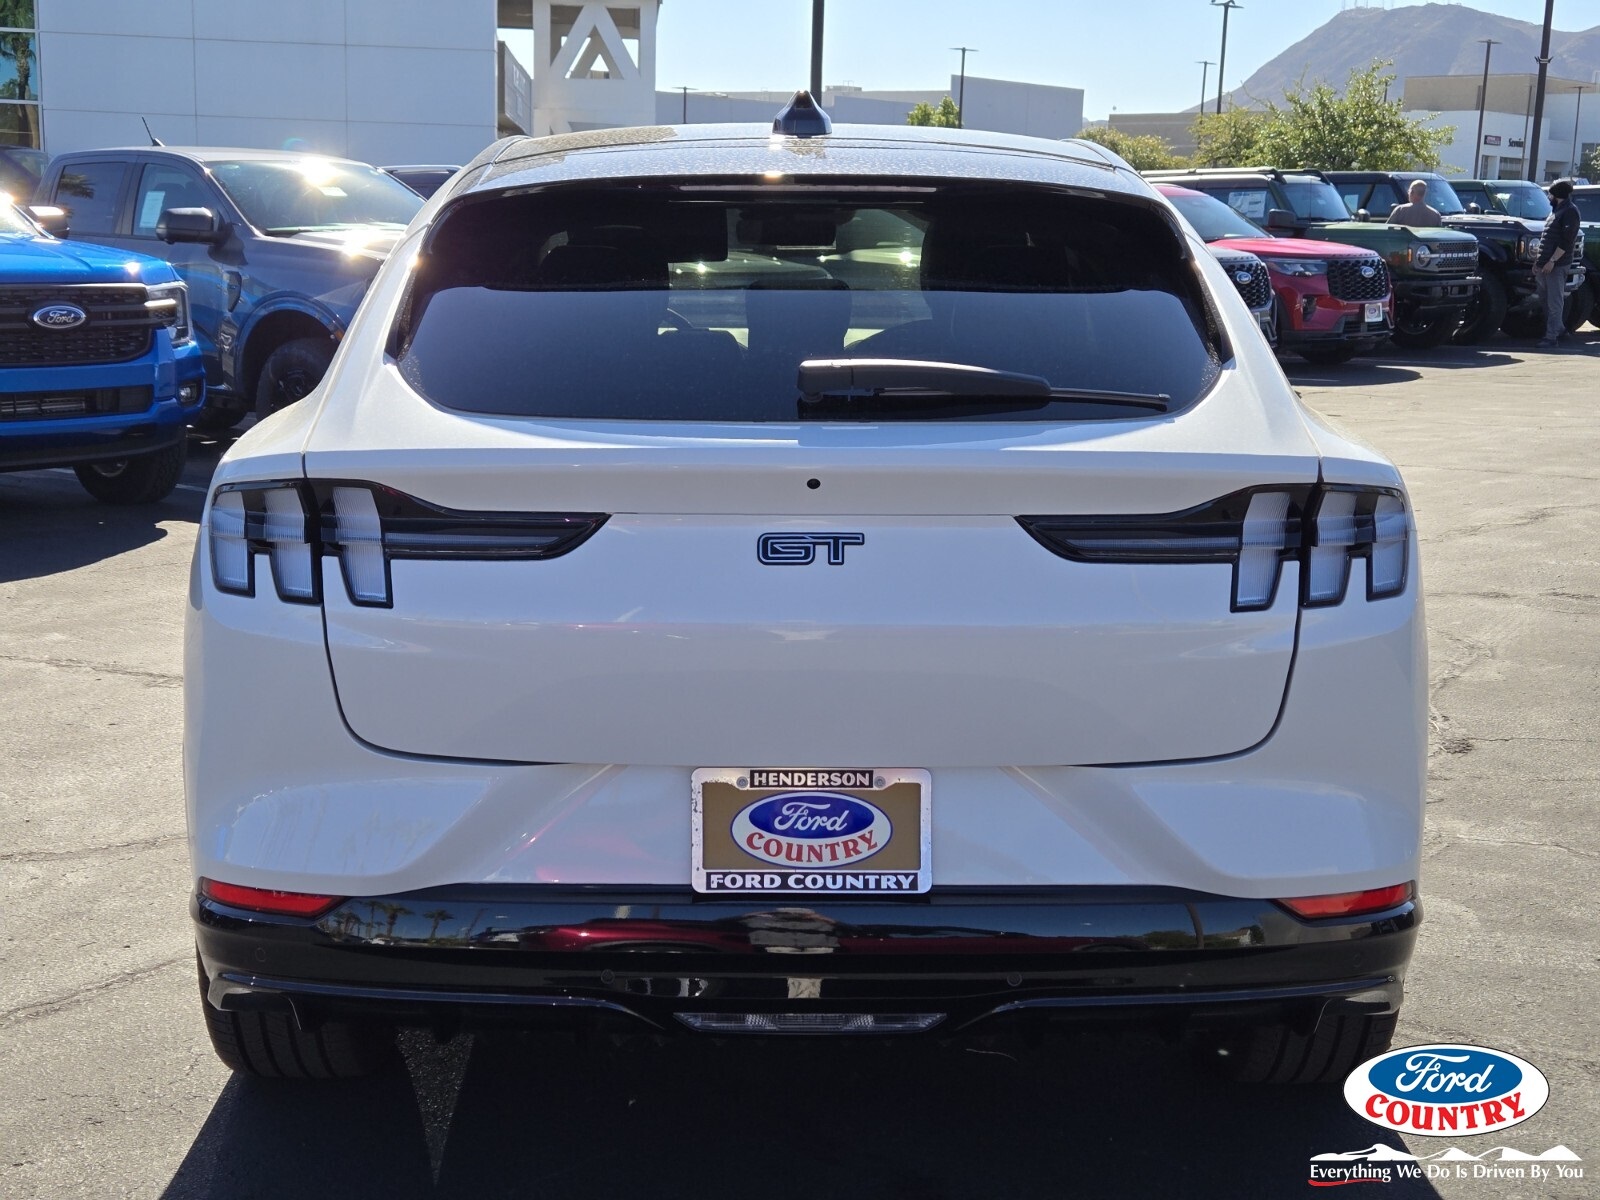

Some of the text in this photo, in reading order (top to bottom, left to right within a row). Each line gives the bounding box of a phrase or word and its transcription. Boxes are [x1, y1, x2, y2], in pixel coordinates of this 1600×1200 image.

[47, 310, 74, 323] Ford
[757, 532, 865, 566] GT
[753, 772, 870, 786] HENDERSON
[773, 801, 850, 831] Ford
[746, 830, 878, 862] COUNTRY
[710, 873, 916, 889] FORD COUNTRY
